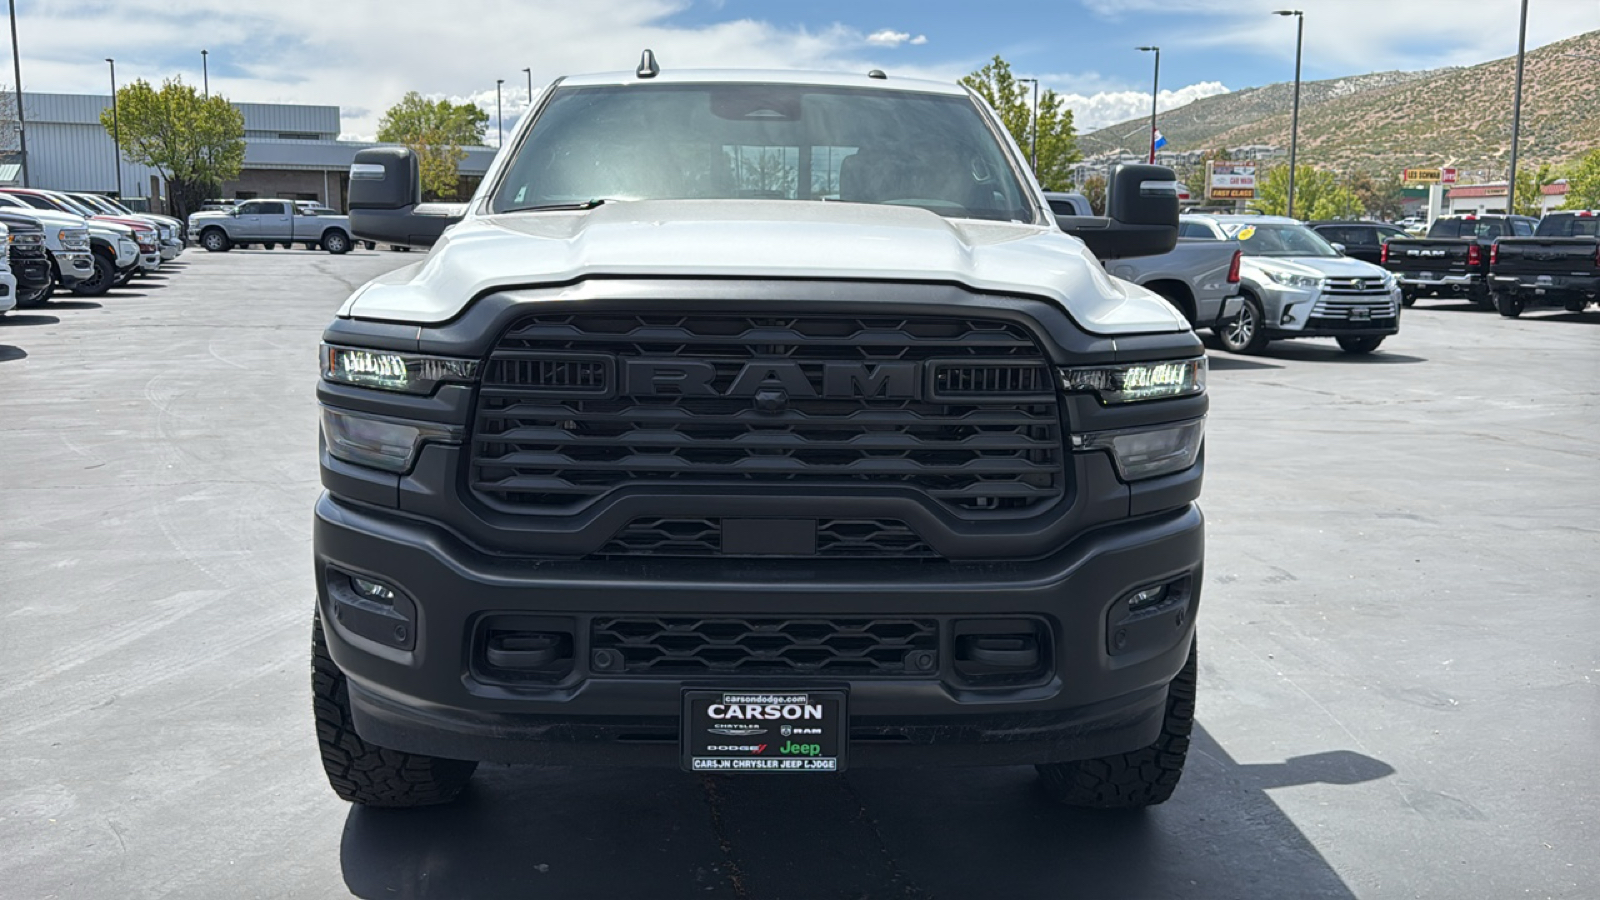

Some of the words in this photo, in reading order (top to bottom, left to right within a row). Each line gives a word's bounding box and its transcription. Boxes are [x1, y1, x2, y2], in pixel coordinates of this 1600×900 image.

[1213, 189, 1230, 197] FAST
[626, 360, 917, 398] RAM
[725, 695, 806, 704] carsondodge.com
[707, 704, 822, 719] CARSON
[780, 741, 820, 756] Jeep
[733, 759, 778, 768] CHRYSLER
[780, 759, 803, 768] JEEP
